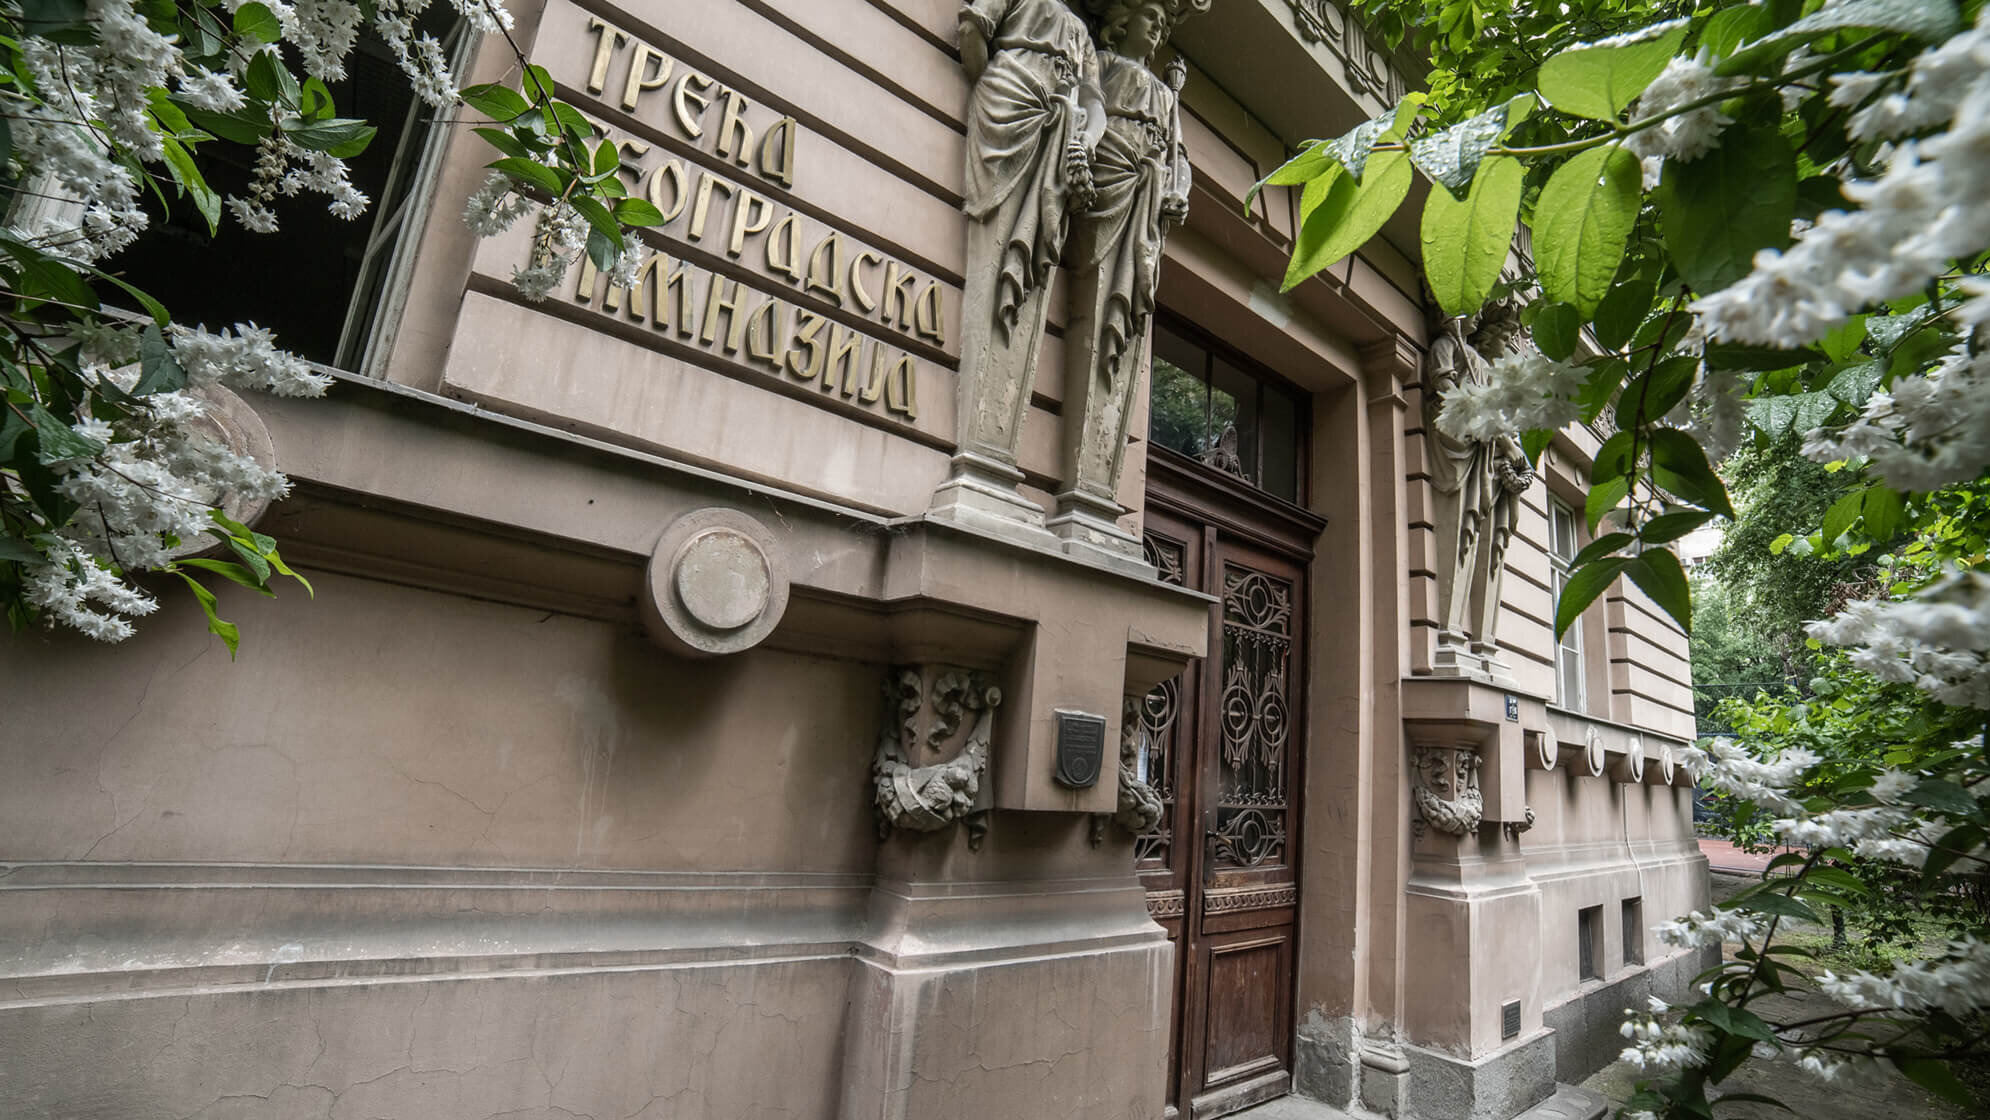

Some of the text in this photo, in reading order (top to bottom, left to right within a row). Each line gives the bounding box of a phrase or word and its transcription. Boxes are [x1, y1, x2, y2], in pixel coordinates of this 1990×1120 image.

[587, 16, 796, 188] ТРЕЋА
[530, 205, 917, 420] МНАЗИЈА
[566, 109, 945, 345] ЕОГРАДСКА
